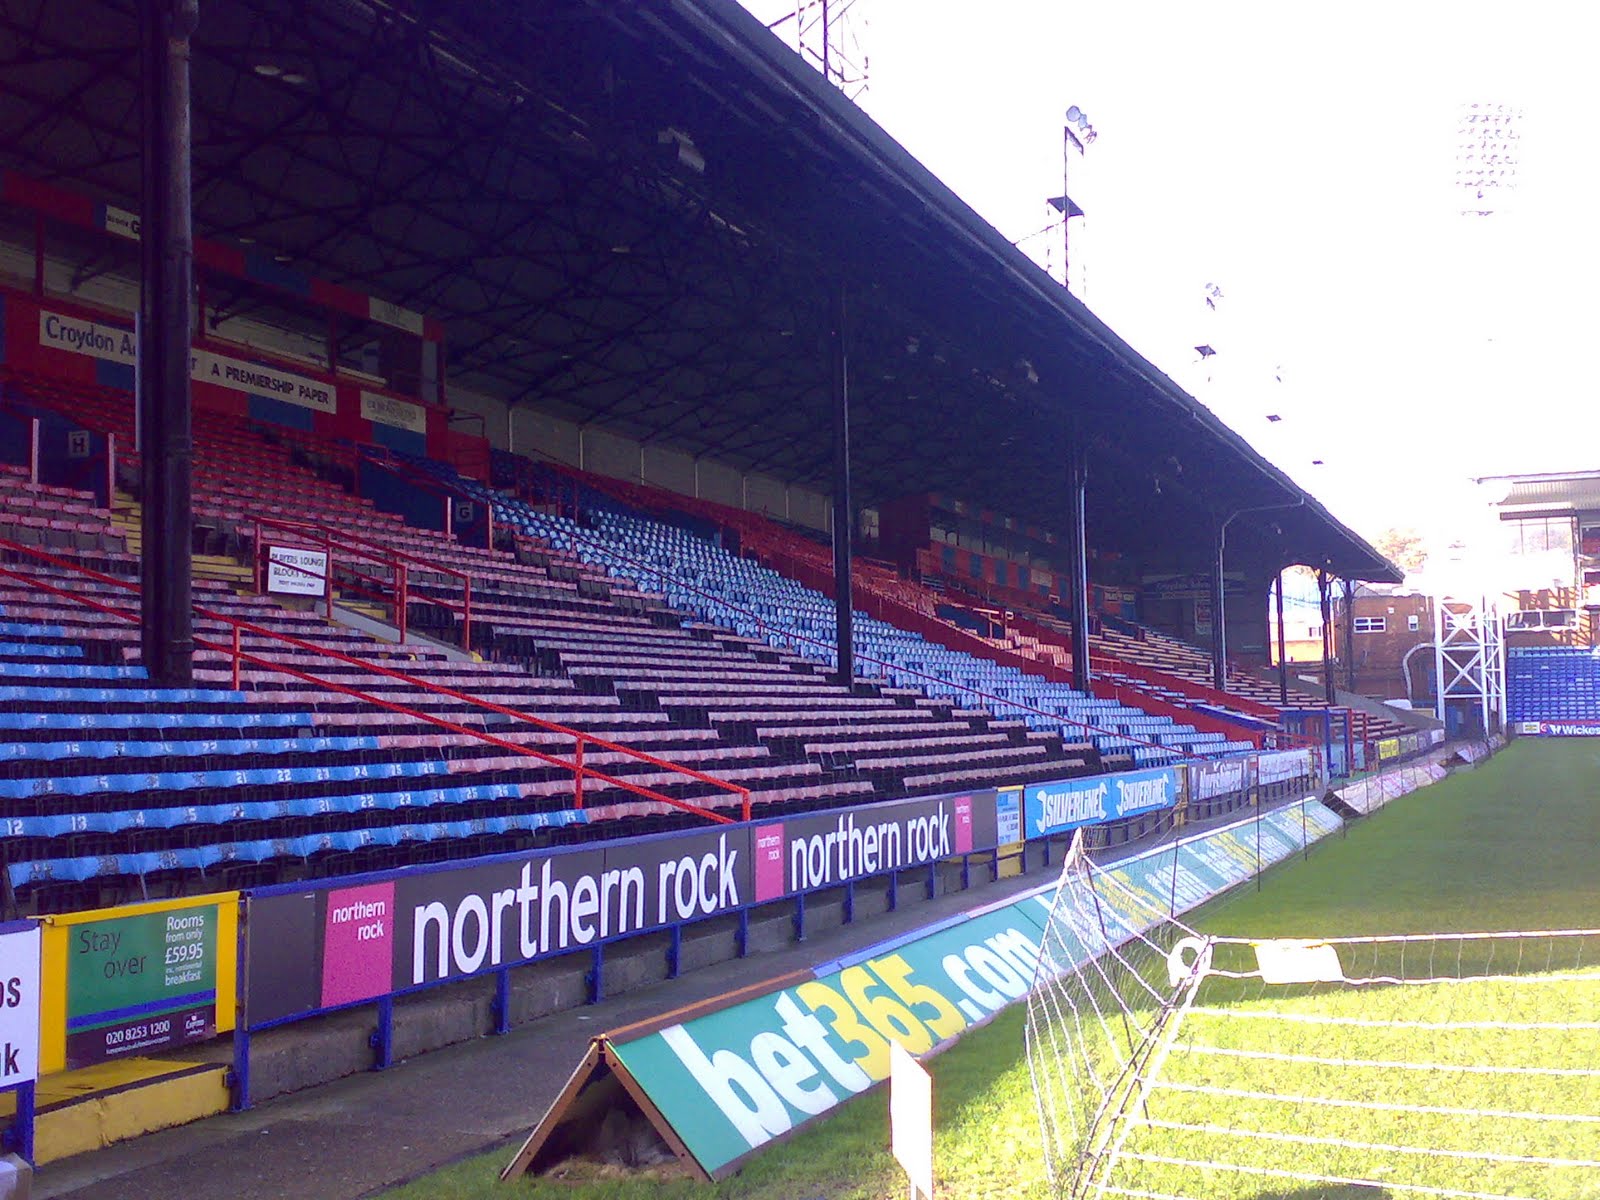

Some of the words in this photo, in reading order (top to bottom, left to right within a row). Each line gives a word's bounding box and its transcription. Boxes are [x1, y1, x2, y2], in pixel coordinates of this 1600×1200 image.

[45, 316, 114, 351] Croydon
[225, 365, 294, 395] PREMIERSHIP
[299, 384, 329, 405] PAPER
[73, 437, 84, 453] H
[361, 795, 375, 808] 22
[6, 819, 24, 835] 12
[71, 815, 87, 831] 13
[791, 813, 901, 891] northern
[907, 801, 950, 864] rock
[332, 901, 386, 924] northern
[413, 858, 645, 985] northern
[658, 833, 739, 924] rock
[166, 915, 204, 931] Rooms
[357, 919, 385, 941] rock
[80, 929, 122, 956] Stay
[165, 932, 184, 943] from
[186, 928, 203, 941] only
[164, 942, 203, 964] £59.95
[104, 955, 147, 980] over
[165, 970, 202, 986] breakfast
[106, 1030, 124, 1045] 020
[125, 1025, 147, 1041] 8253
[150, 1020, 170, 1036] 1200
[659, 928, 1062, 1149] bet365.com
